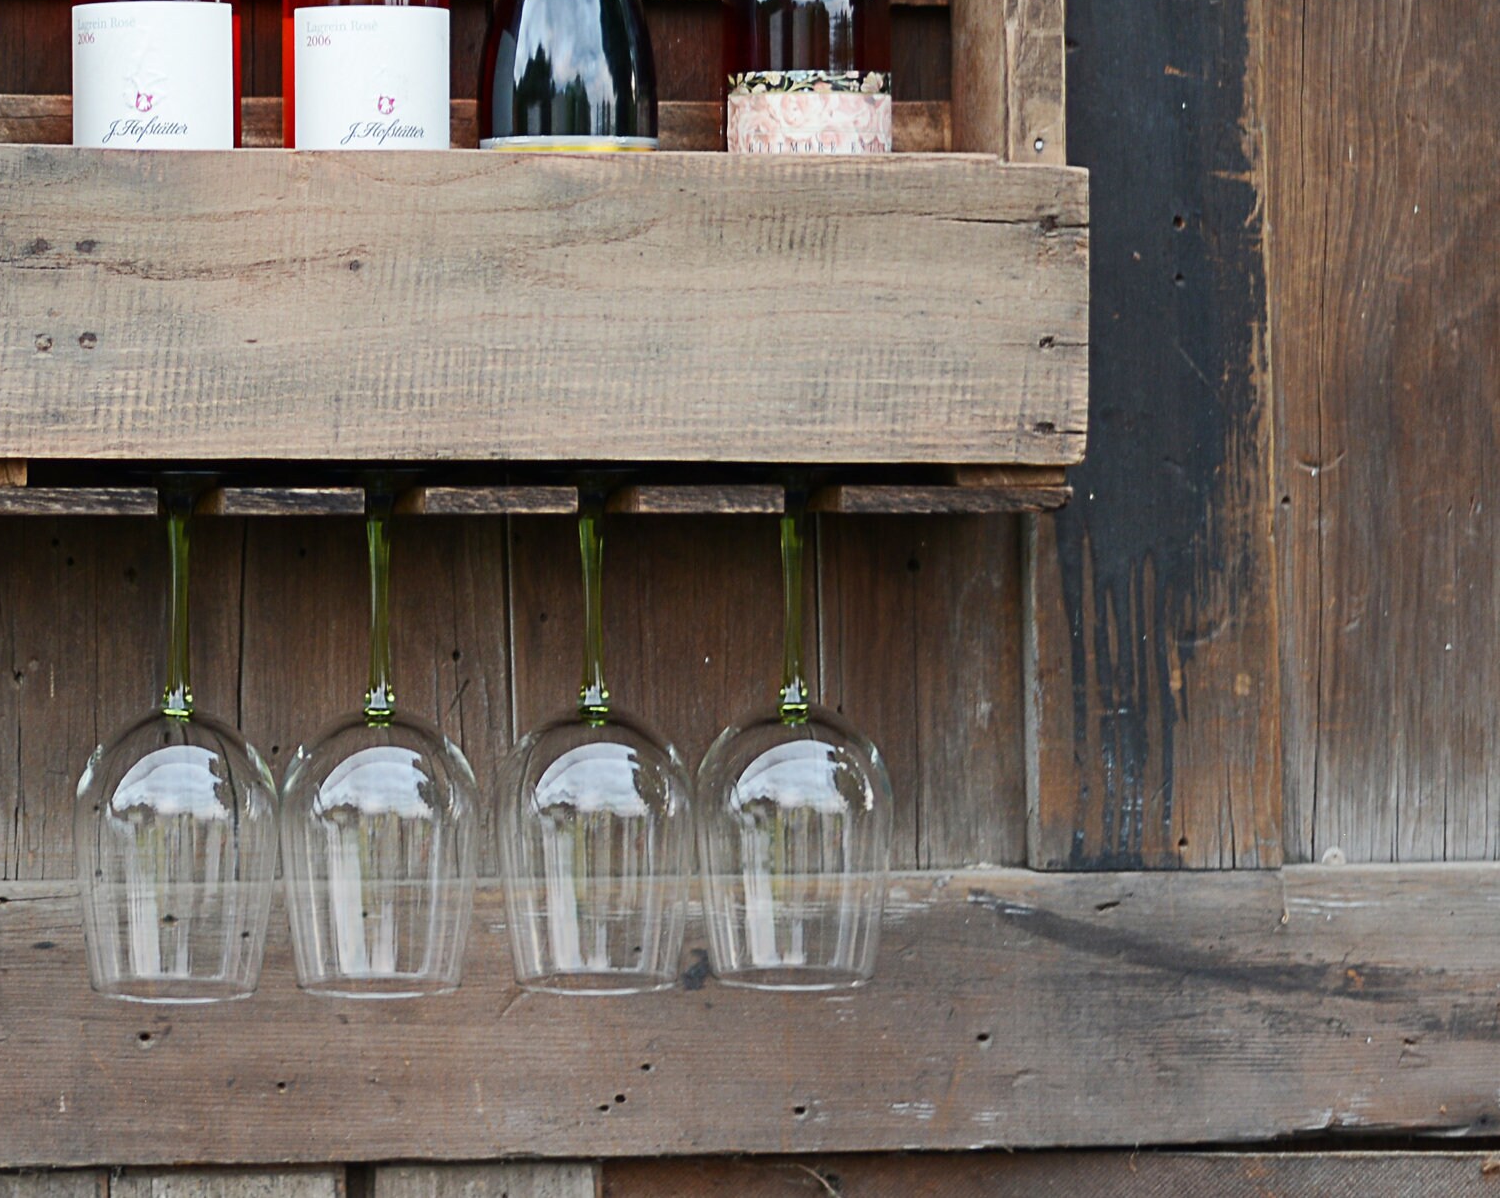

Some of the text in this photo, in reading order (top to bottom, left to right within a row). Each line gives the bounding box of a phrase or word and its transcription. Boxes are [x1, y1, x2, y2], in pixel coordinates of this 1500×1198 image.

[77, 32, 95, 45] 2006
[306, 34, 332, 48] 2006
[748, 141, 836, 153] BILTMORE
